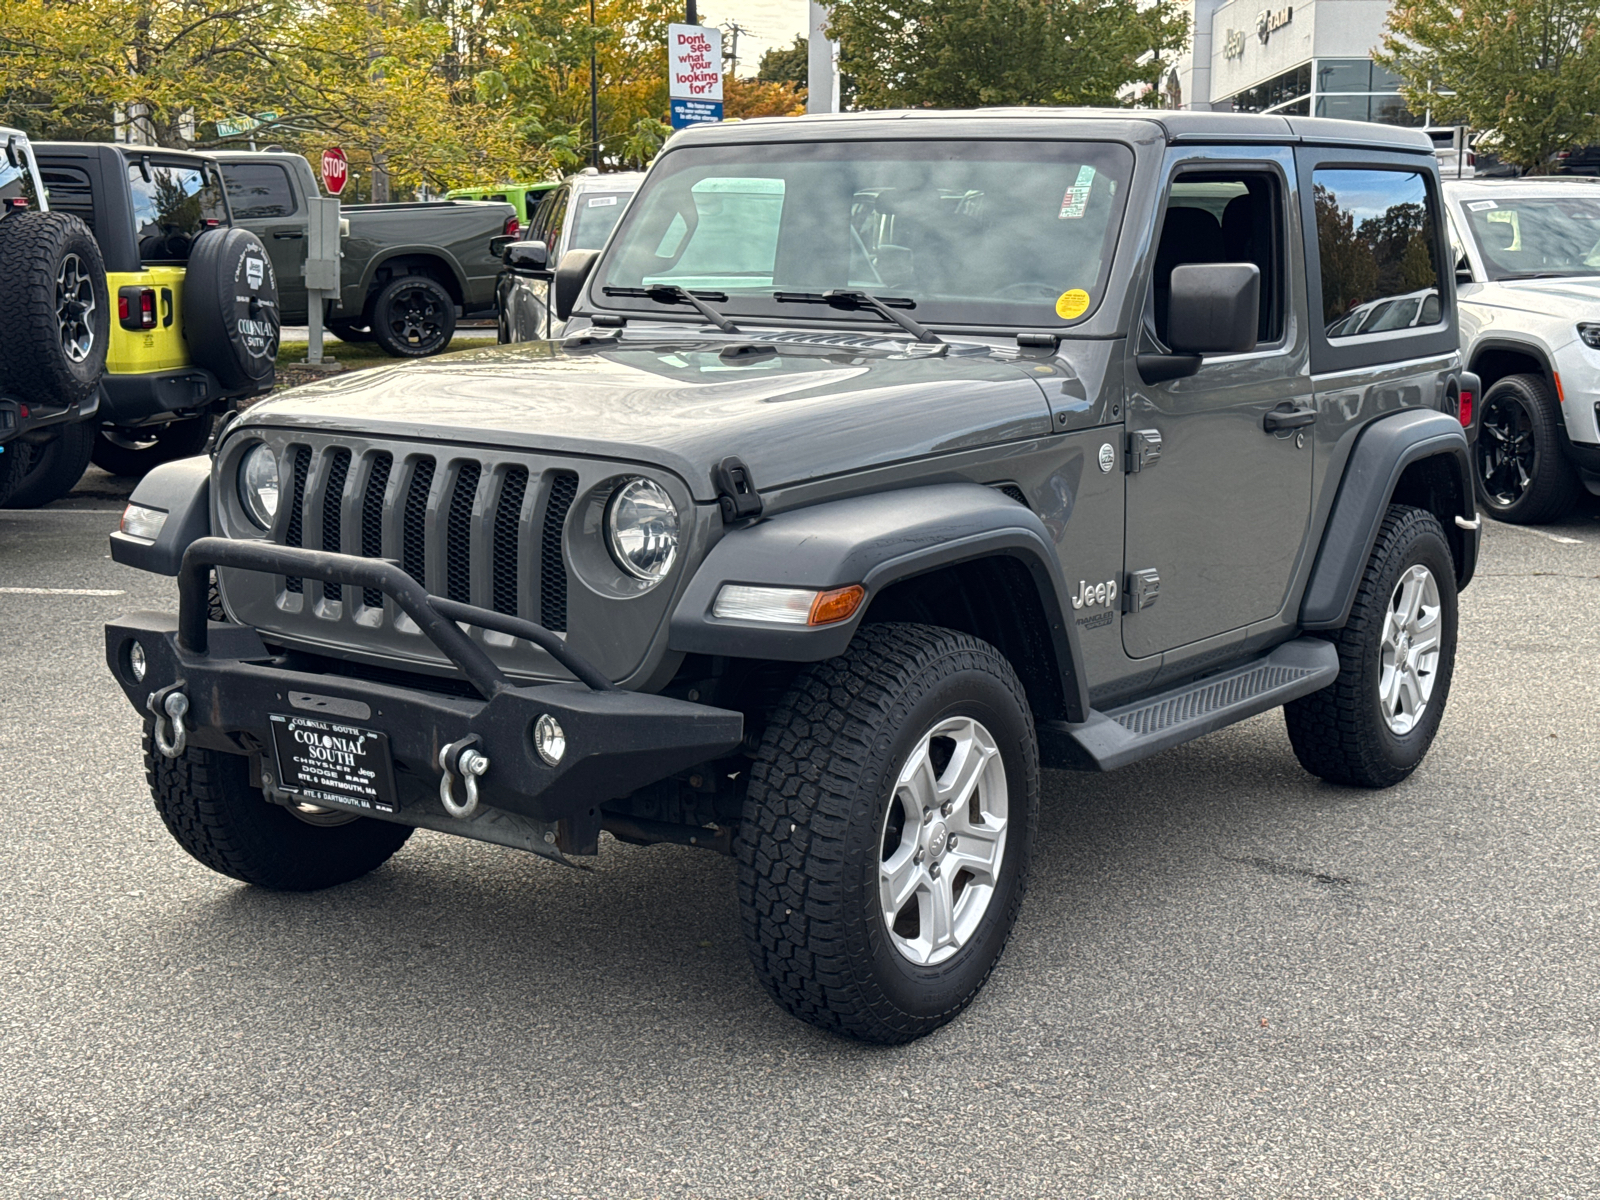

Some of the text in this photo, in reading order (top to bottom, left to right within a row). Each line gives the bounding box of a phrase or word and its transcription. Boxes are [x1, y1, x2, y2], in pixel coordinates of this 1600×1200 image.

[1266, 7, 1292, 32] RAM
[677, 33, 705, 45] Dont
[690, 43, 712, 53] see
[678, 53, 705, 63] what
[689, 61, 712, 72] your
[676, 71, 718, 84] looking
[689, 82, 713, 94] for?
[323, 156, 346, 178] STOP
[1071, 579, 1117, 610] Jeep
[292, 718, 329, 731] COLONIAL
[332, 725, 360, 736] SOUTH
[294, 729, 366, 755] COLONIAL
[308, 745, 355, 766] SOUTH
[293, 756, 375, 778] CHRYSLER Jeep
[301, 765, 338, 779] DODGE
[321, 778, 365, 794] DARTMOUTH,
[366, 787, 377, 795] MA
[323, 794, 360, 807] DARTMOUTH,
[361, 800, 371, 809] MA
